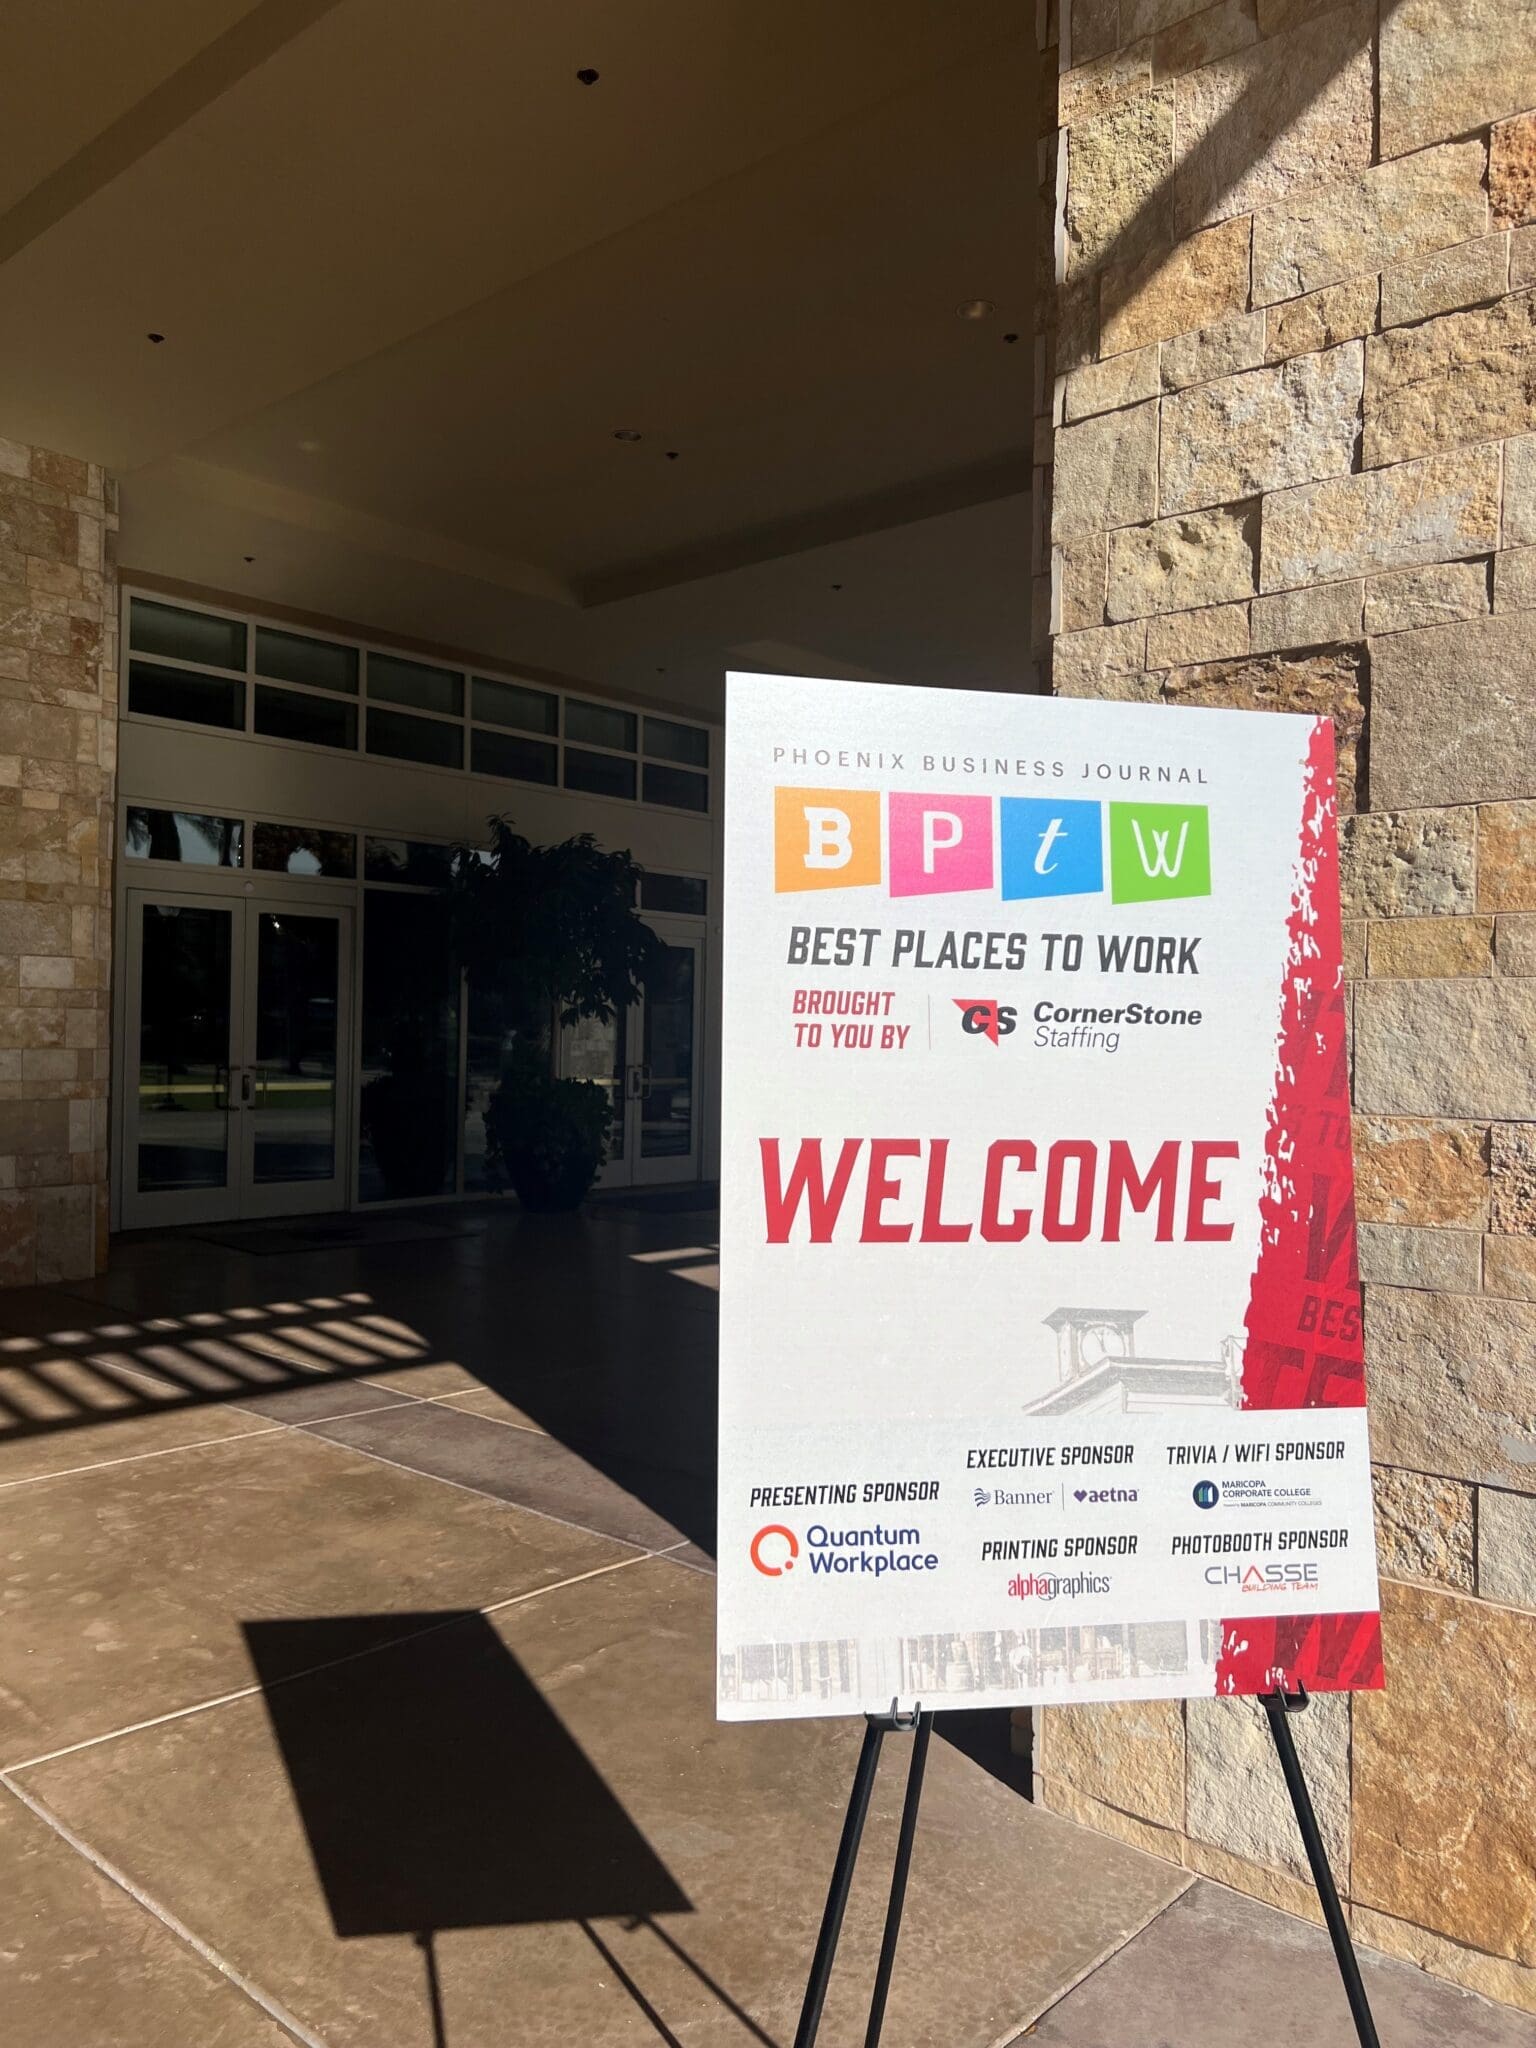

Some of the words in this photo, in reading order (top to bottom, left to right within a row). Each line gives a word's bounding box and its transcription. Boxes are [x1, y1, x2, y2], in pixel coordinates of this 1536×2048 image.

[773, 747, 904, 770] PHOENIX
[923, 755, 1064, 778] BUSINESS
[1081, 763, 1208, 784] JOURNAL
[787, 926, 881, 967] BEST
[891, 929, 1028, 971] PLACES
[1041, 933, 1084, 972] TO
[1097, 934, 1202, 975] WORK
[792, 989, 895, 1016] BROUGHT
[1033, 1001, 1203, 1026] CornerStone
[794, 1023, 823, 1049] TO
[831, 1024, 873, 1049] YOU
[880, 1025, 910, 1050] BY
[1033, 1026, 1121, 1053] Staffing
[759, 1138, 1240, 1243] WELCOME
[967, 1447, 1056, 1469] EXECUTIVE
[1061, 1445, 1134, 1466] SPONSOR
[1167, 1445, 1217, 1465] TRIVIA
[1222, 1444, 1230, 1463] /
[1235, 1443, 1270, 1463] WIFI
[1275, 1441, 1345, 1462] SPONSOR
[750, 1484, 857, 1507] PRESENTING
[863, 1481, 940, 1502] SPONSOR
[1089, 1487, 1138, 1503] aetna
[1222, 1480, 1266, 1488] MARICOPA
[1222, 1489, 1272, 1498] CORPORATE
[1273, 1488, 1311, 1496] COLLEGE
[995, 1489, 1053, 1505] Banner
[807, 1524, 920, 1547] Quantum
[1172, 1532, 1272, 1555] PHOTOBOOTH
[1278, 1529, 1349, 1550] SPONSOR
[982, 1539, 1058, 1561] PRINTING
[1064, 1536, 1138, 1557] SPONSOR
[809, 1550, 939, 1577] Workplace
[1205, 1563, 1318, 1584] CHASSE
[1008, 1571, 1110, 1600] alphagraphics
[1242, 1584, 1287, 1592] BUILDING
[1292, 1582, 1318, 1590] TEAM
